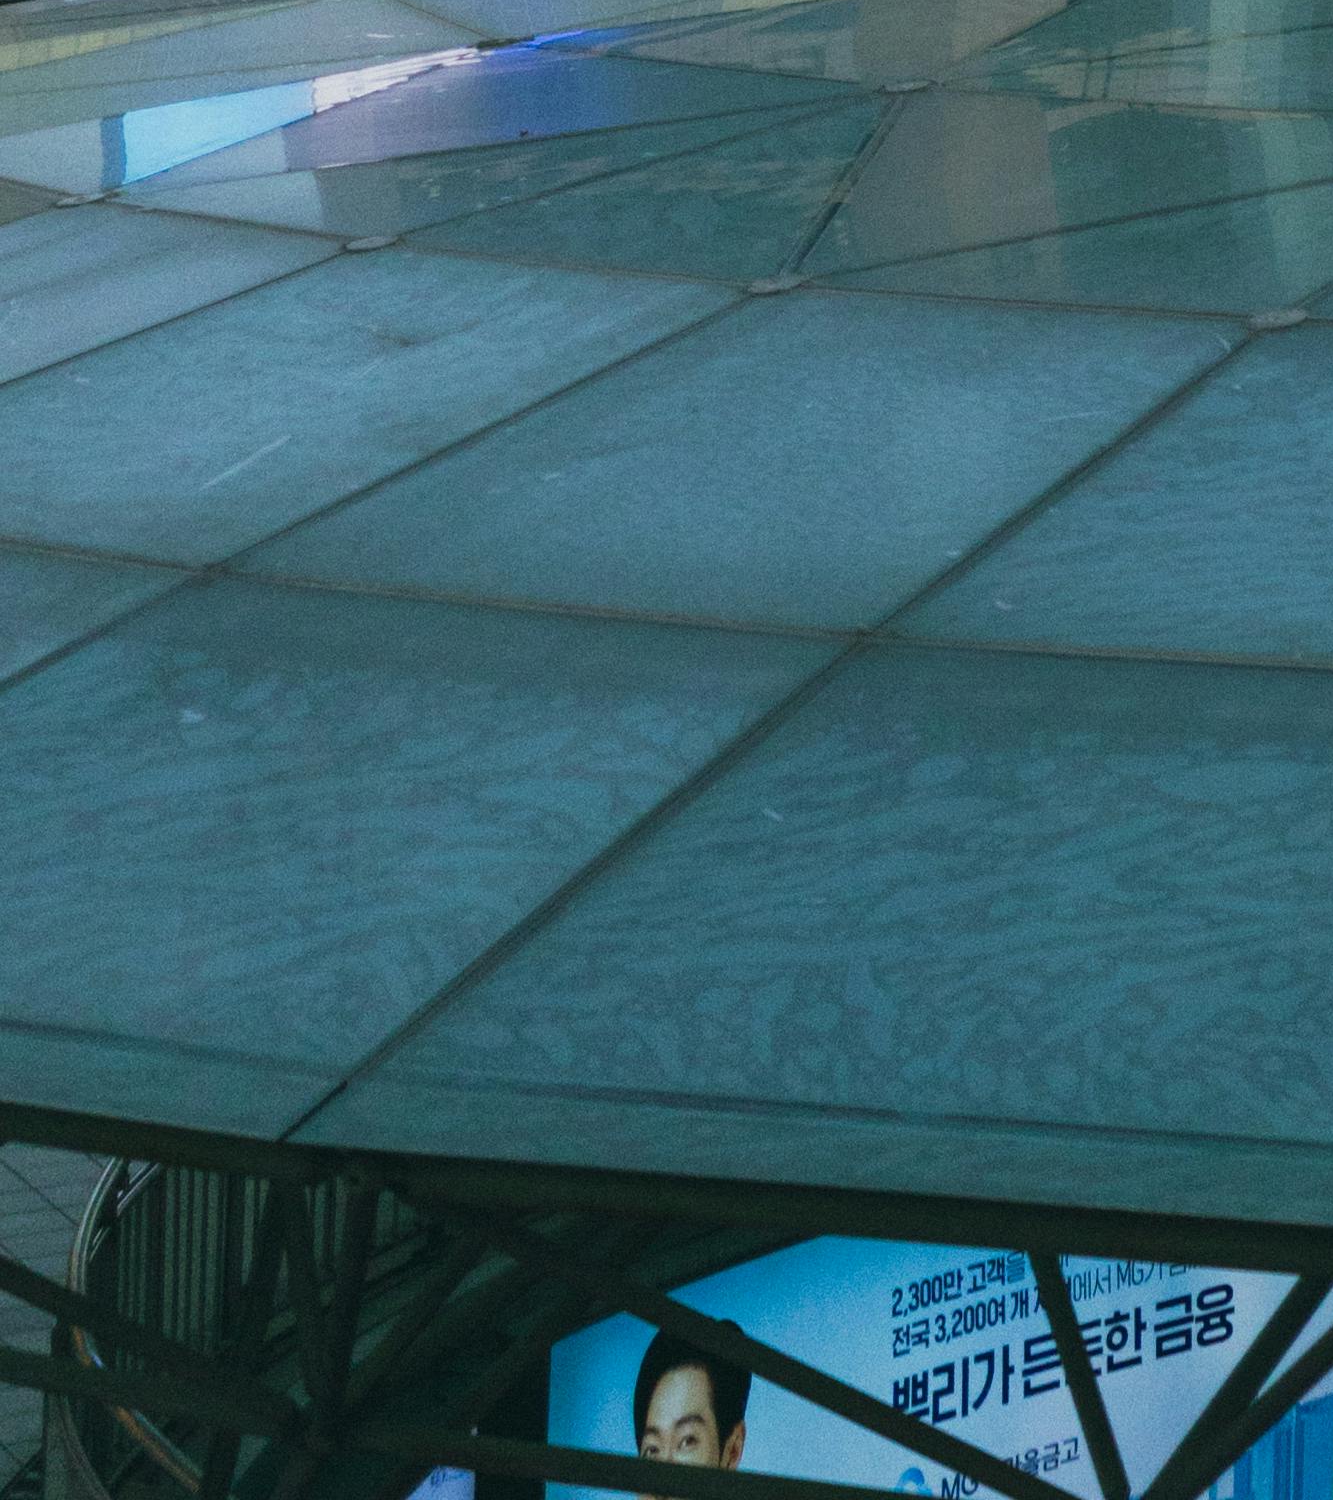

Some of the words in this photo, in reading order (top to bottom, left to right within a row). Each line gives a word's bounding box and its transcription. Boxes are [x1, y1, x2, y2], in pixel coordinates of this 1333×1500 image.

[891, 1271, 964, 1318] 2,300만
[891, 1318, 931, 1359] 전국
[933, 1298, 1007, 1346] 3,200여
[1010, 1286, 1030, 1320] 개
[1153, 1283, 1236, 1360] 금융
[1002, 1436, 1081, 1477] 마을금고
